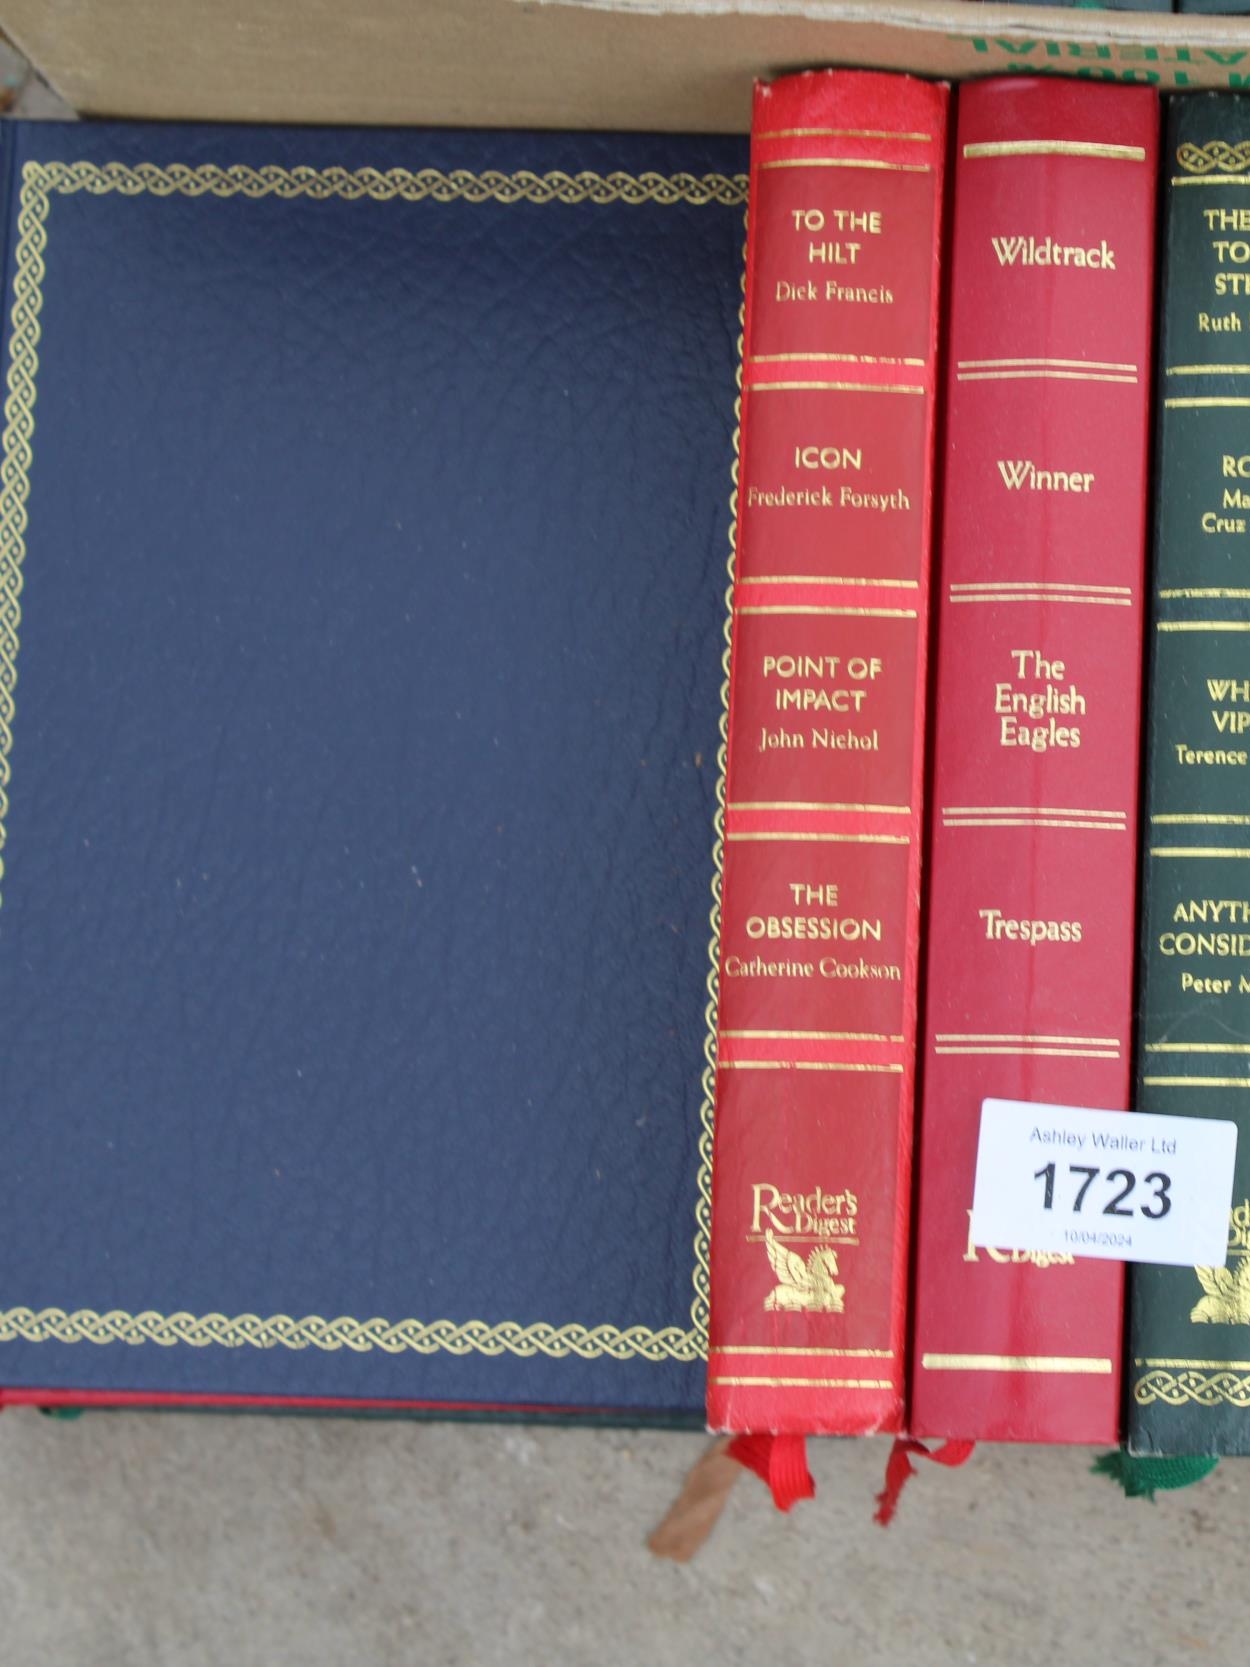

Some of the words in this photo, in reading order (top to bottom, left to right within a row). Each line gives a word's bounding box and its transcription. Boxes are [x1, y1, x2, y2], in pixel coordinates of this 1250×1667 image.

[792, 209, 824, 231] TO
[834, 210, 881, 233] THE
[809, 242, 860, 264] HILT
[992, 237, 1115, 269] Wildtrack
[1213, 241, 1250, 263] TO
[776, 280, 817, 301] Dick
[826, 281, 893, 303] Francis
[1199, 312, 1241, 331] Ruth
[795, 447, 862, 469] ICON
[998, 461, 1094, 492] Winner
[749, 486, 832, 506] Frederick
[840, 487, 910, 512] Forsyth
[1202, 512, 1245, 533] Cruz
[764, 656, 840, 678] POINT
[848, 658, 881, 680] OF
[1011, 650, 1065, 680] The
[776, 689, 866, 712] IMPACT
[995, 683, 1085, 719] English
[759, 728, 804, 752] John
[812, 728, 878, 750] Nichol
[1000, 716, 1080, 752] Eagles
[1176, 745, 1247, 765] Terence
[790, 884, 838, 906] THE
[746, 916, 881, 941] OBSESSION
[979, 910, 1082, 945] Trespass
[725, 956, 814, 977] Catherine
[819, 958, 900, 980] Cookson
[1182, 973, 1231, 993] Peter
[1030, 1127, 1086, 1148] Ashley
[1092, 1133, 1143, 1151] Waller
[1152, 1138, 1176, 1154] Ltd
[1034, 1163, 1171, 1219] 1723
[751, 1184, 858, 1234] Reader's
[795, 1211, 856, 1237] Digest
